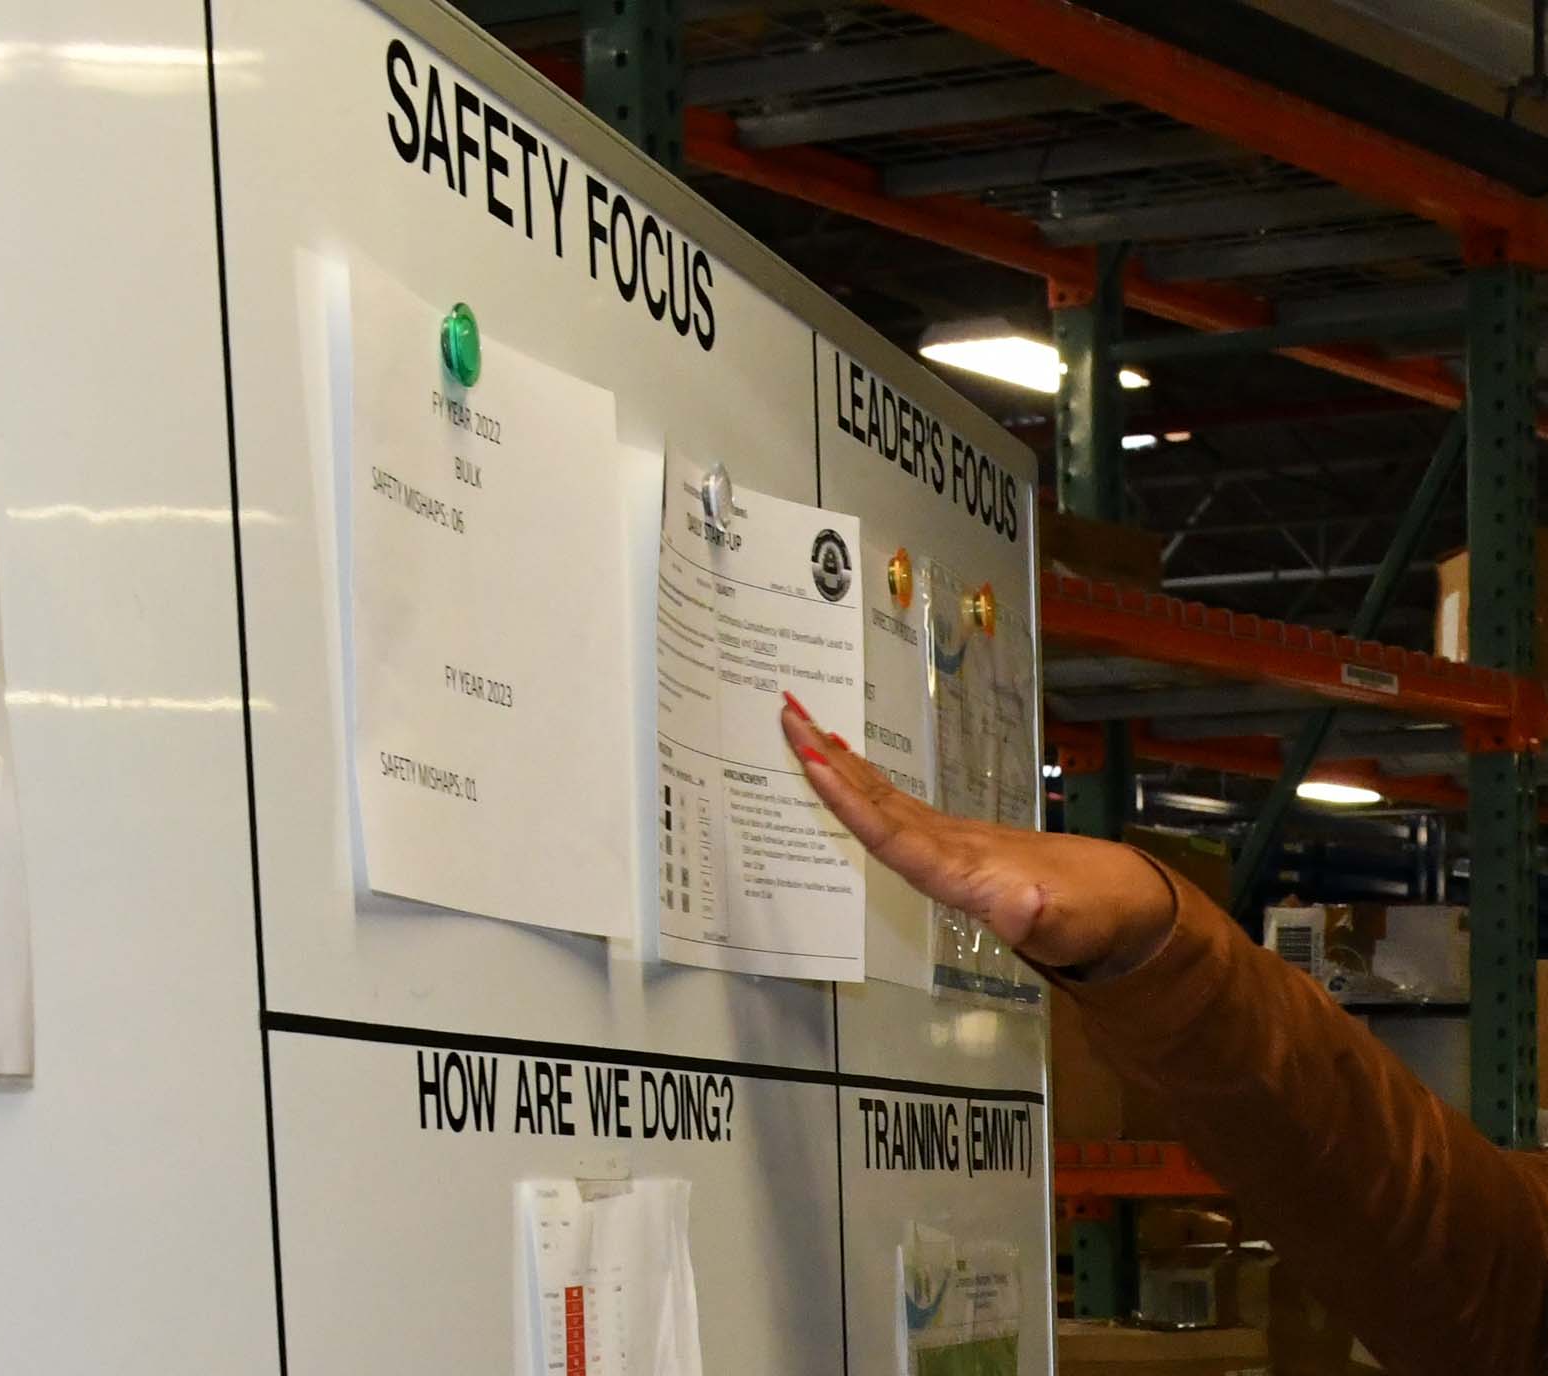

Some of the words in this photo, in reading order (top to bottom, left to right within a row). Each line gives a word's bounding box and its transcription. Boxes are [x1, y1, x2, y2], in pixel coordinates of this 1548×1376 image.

[386, 39, 569, 259] SAFETY
[586, 175, 716, 352] FOCUS
[475, 411, 502, 446] 2022
[836, 352, 945, 495] LEADER'S
[952, 433, 1017, 543] FOCUS
[371, 466, 402, 502] SAFETY
[454, 456, 483, 489] BULK
[458, 669, 485, 700] YEAR
[486, 680, 513, 708] 2023
[380, 751, 417, 783] SAFETY
[417, 1050, 498, 1133] HOW
[514, 1060, 576, 1136] ARE
[585, 1065, 632, 1138] WE
[640, 1070, 735, 1142] DOING?
[859, 1098, 960, 1172] TRAINING
[966, 1098, 1033, 1179] (EMWT)
